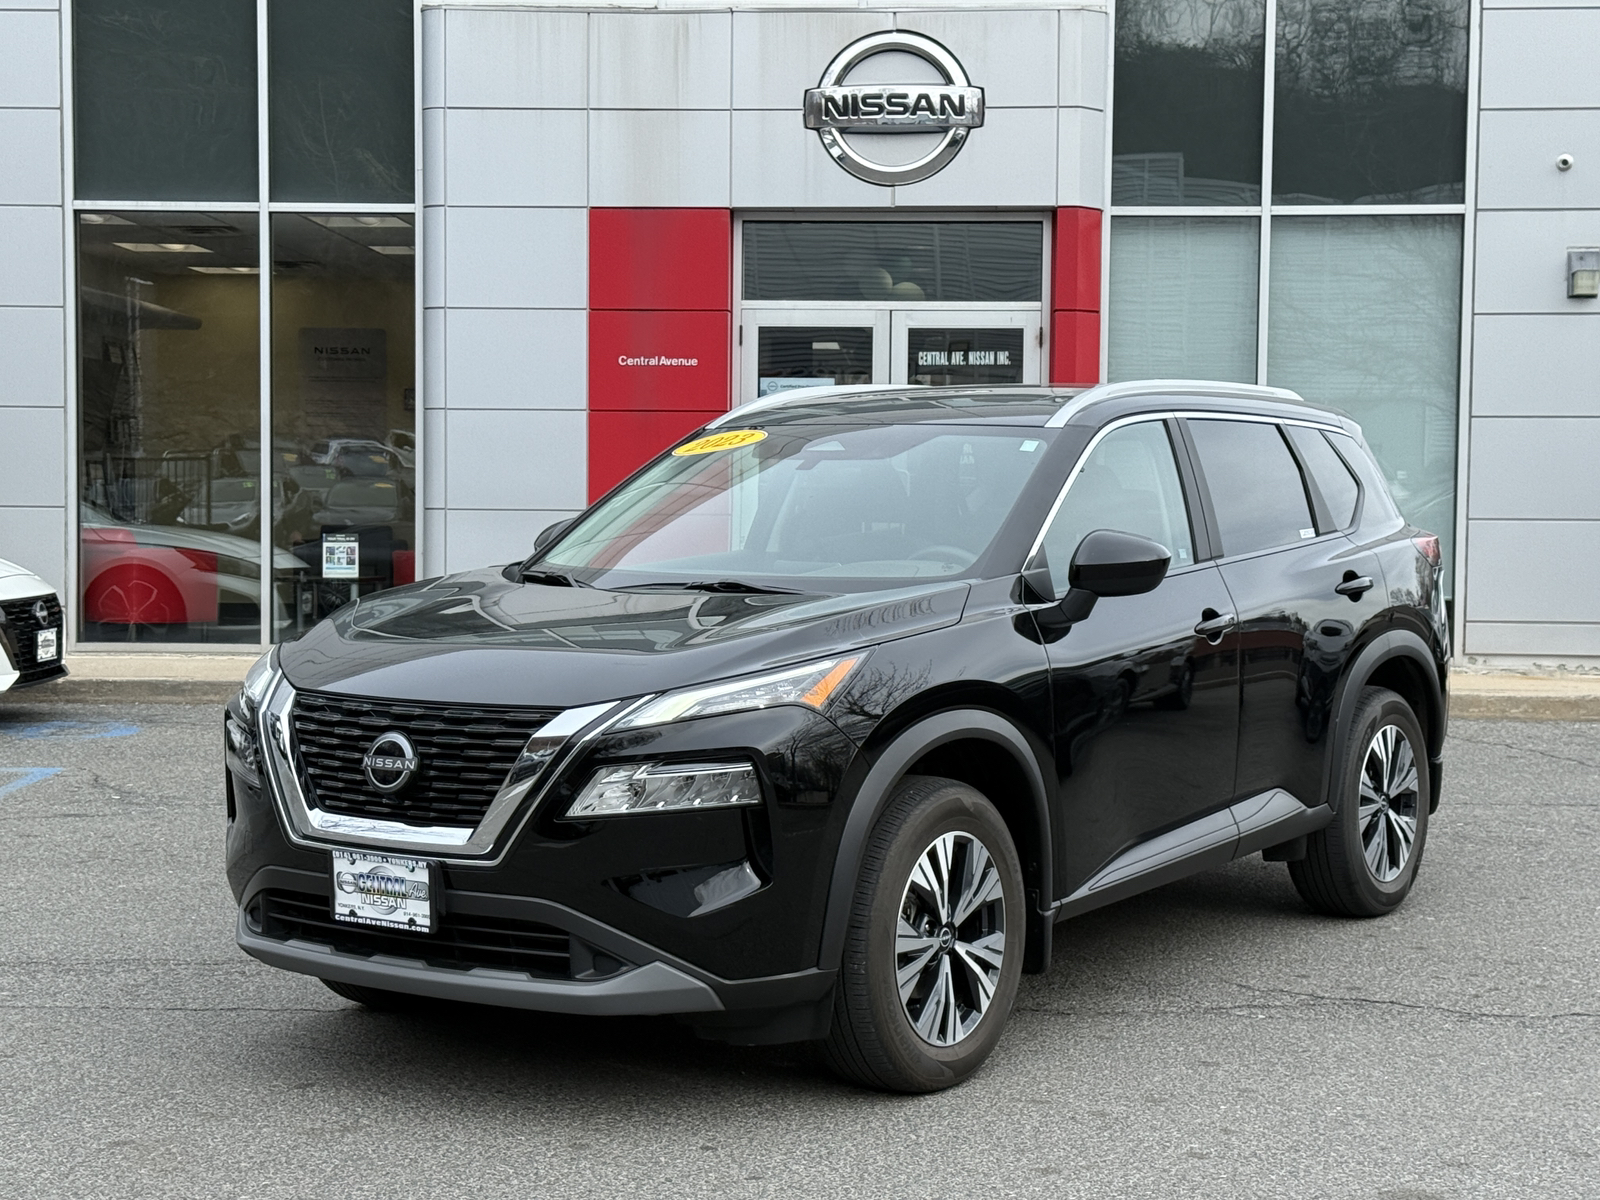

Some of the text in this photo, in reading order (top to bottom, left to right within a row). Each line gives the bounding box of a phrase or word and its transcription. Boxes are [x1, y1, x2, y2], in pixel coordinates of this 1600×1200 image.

[822, 92, 966, 119] NISSAN
[314, 346, 371, 355] NISSAN
[918, 350, 1012, 366] CENTRAL AVE. NISSAN INC.
[618, 355, 699, 367] Central Avenue
[683, 432, 756, 453] 2023
[363, 756, 415, 769] NISSAN
[358, 872, 408, 898] CENTRAL
[361, 893, 407, 910] NISSAN
[334, 914, 430, 933] CentralAveNissan.com
